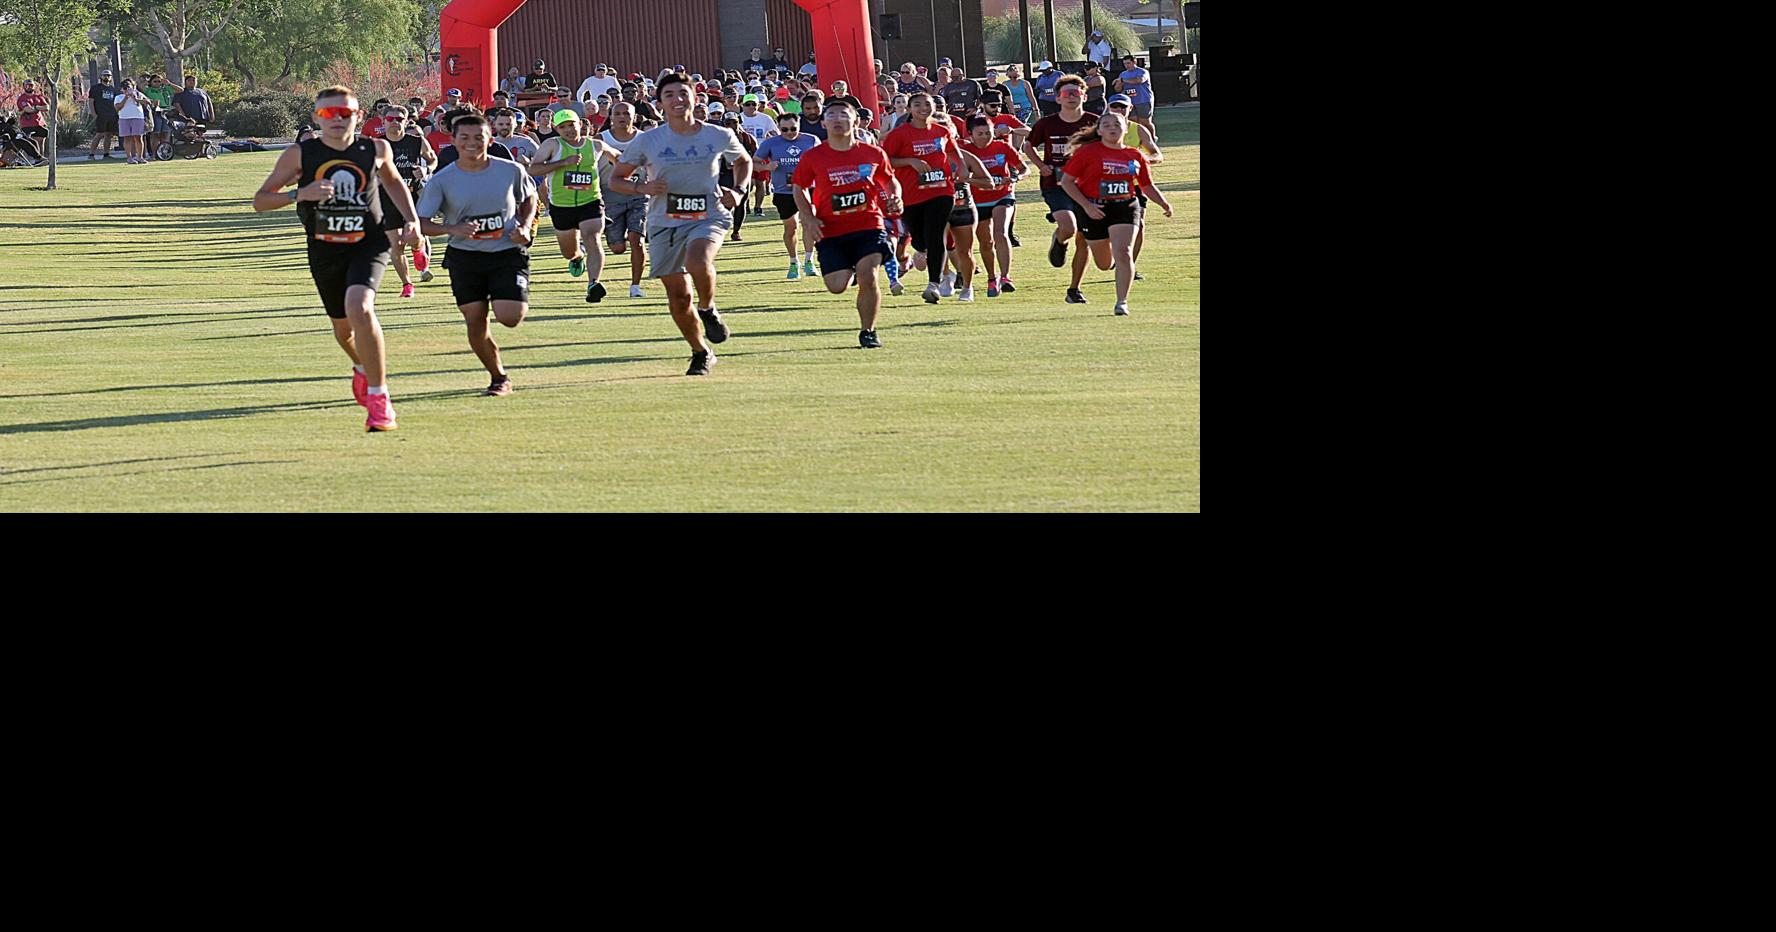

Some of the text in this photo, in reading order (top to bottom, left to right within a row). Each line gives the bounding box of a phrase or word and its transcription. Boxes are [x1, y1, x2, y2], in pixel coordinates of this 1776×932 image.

[571, 174, 592, 184] 1815
[925, 171, 945, 181] 1862
[1107, 183, 1129, 194] 1761
[676, 198, 706, 211] 1863
[840, 192, 866, 207] 1779
[327, 216, 364, 231] 1752
